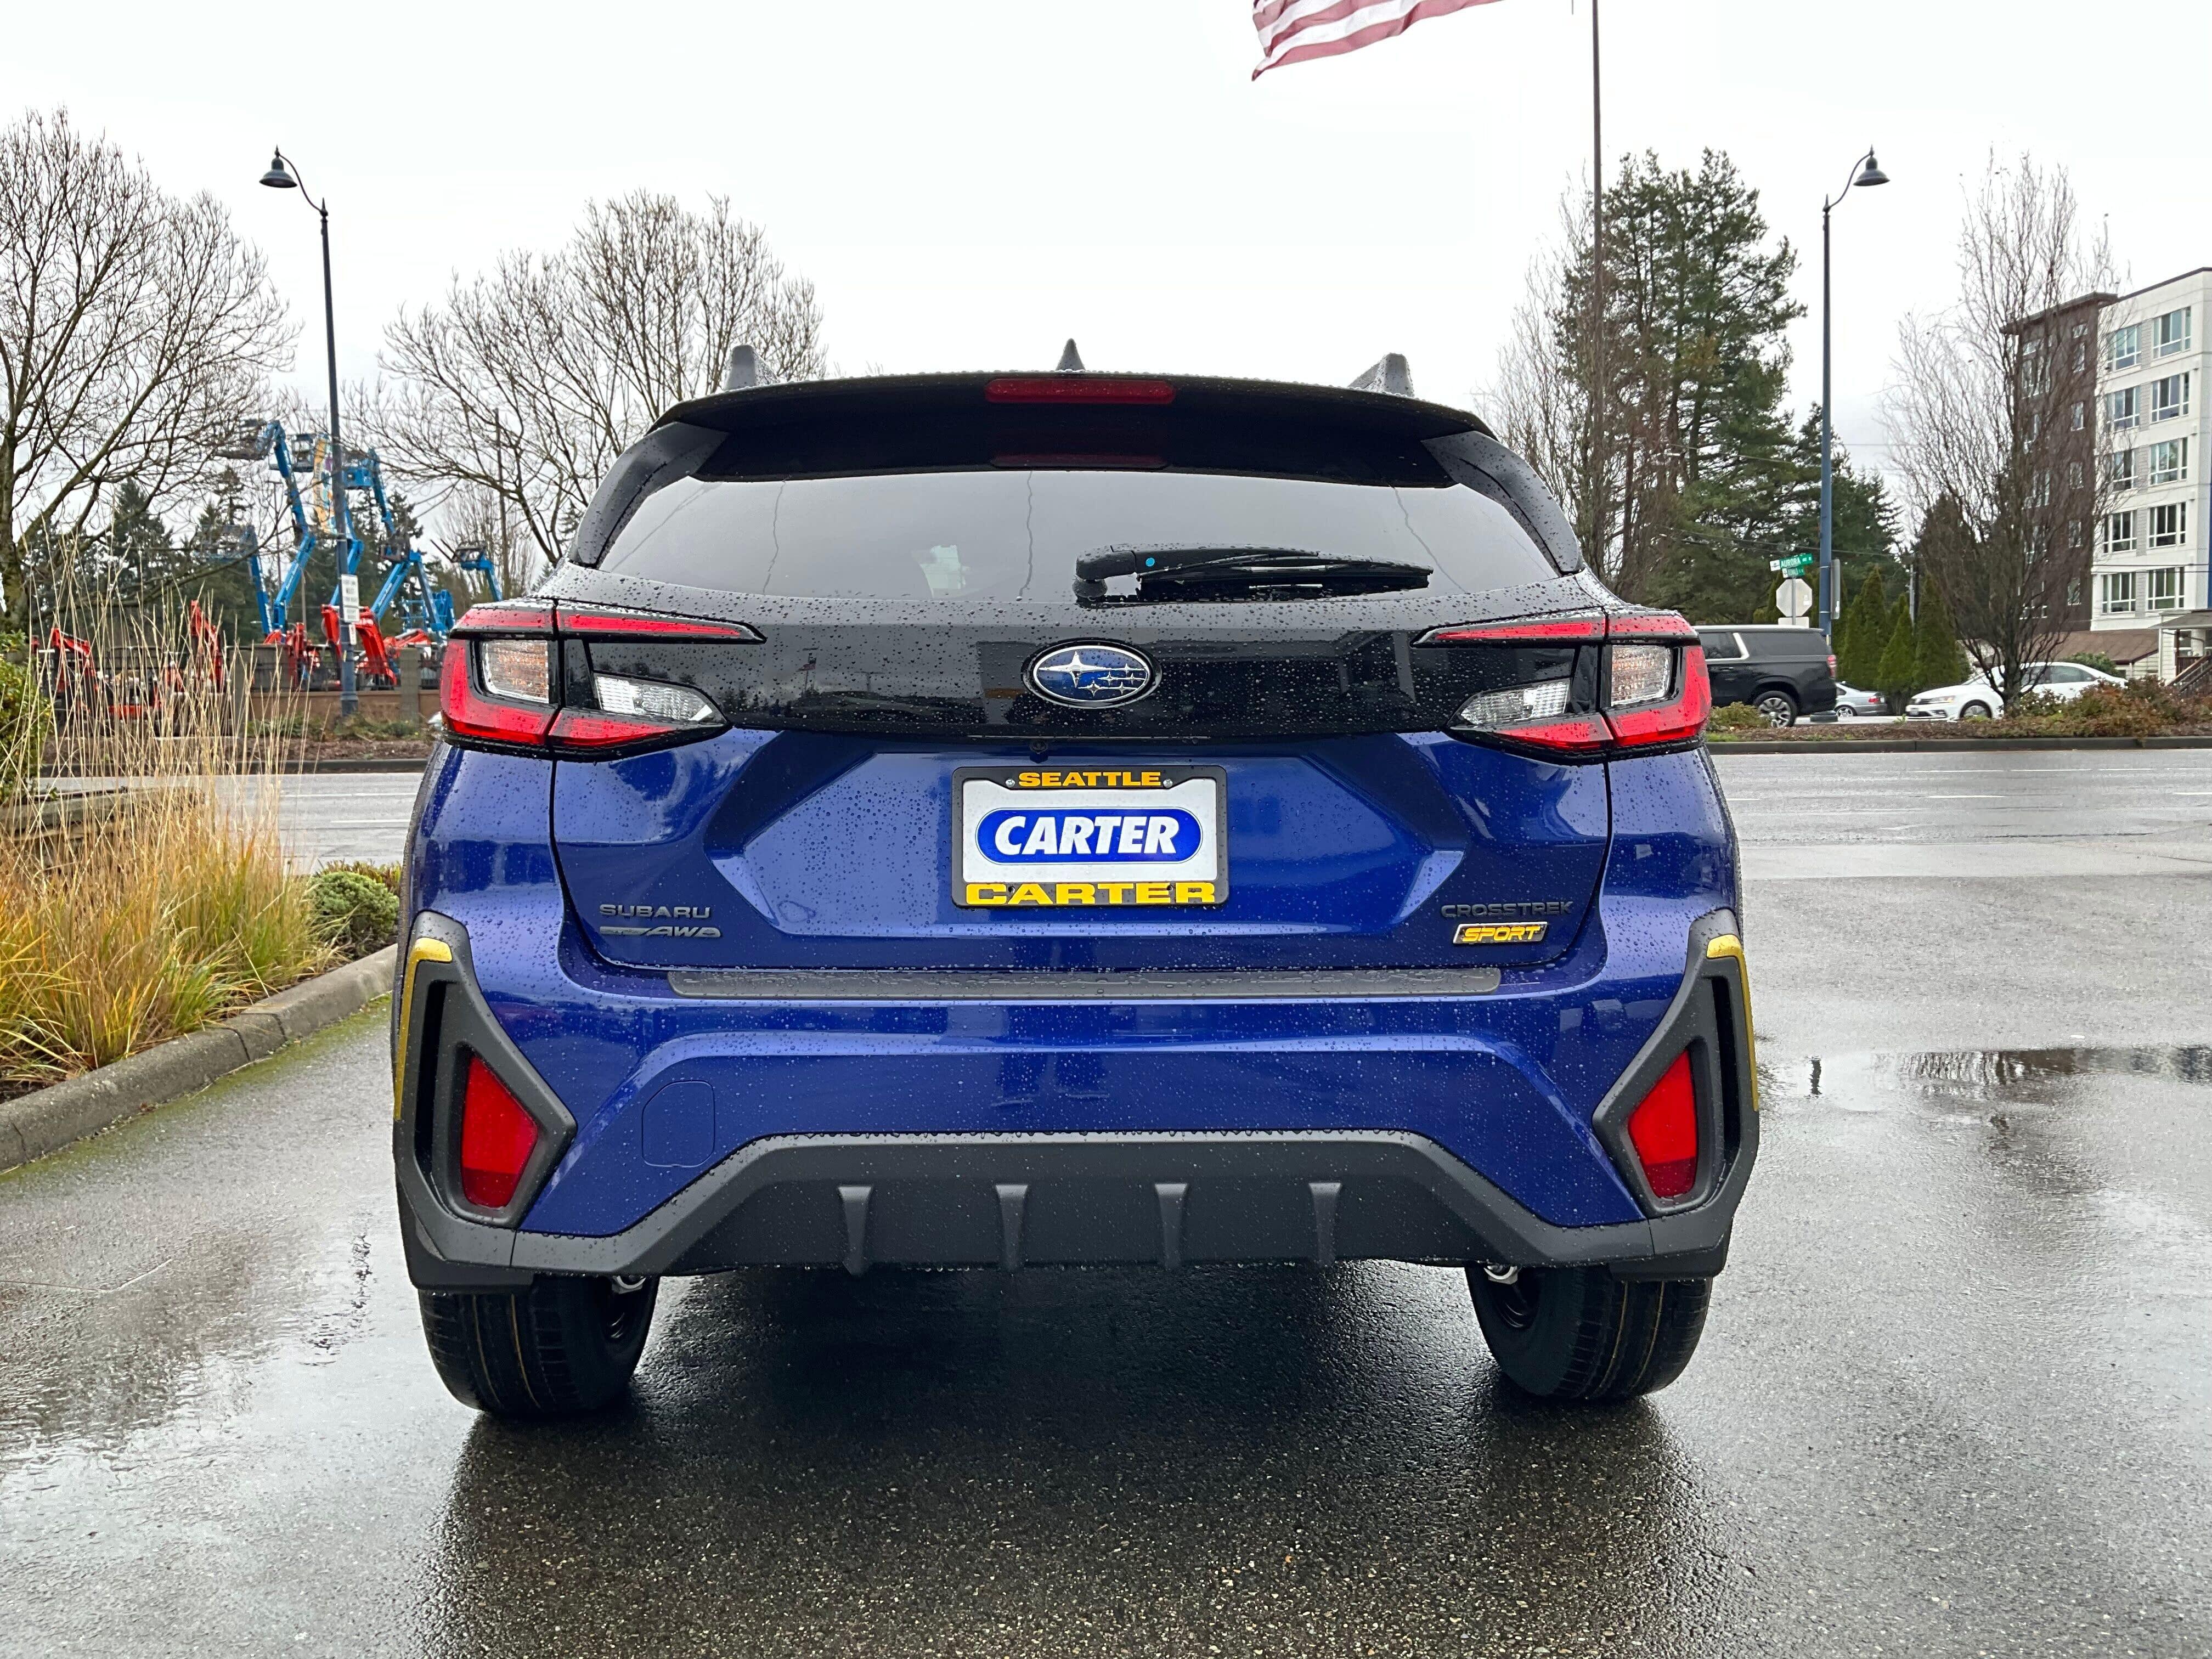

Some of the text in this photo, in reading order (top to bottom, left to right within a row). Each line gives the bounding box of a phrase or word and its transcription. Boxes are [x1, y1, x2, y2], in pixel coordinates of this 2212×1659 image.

[1781, 557, 1801, 568] AURORA
[1018, 771, 1161, 787] SEATTLE
[994, 815, 1180, 855] CARTER
[966, 882, 1216, 905] CARTER
[599, 904, 711, 918] SUBARU
[1441, 901, 1573, 918] CROSSTREK
[642, 926, 721, 938] AWD
[1462, 926, 1541, 942] SPORT
